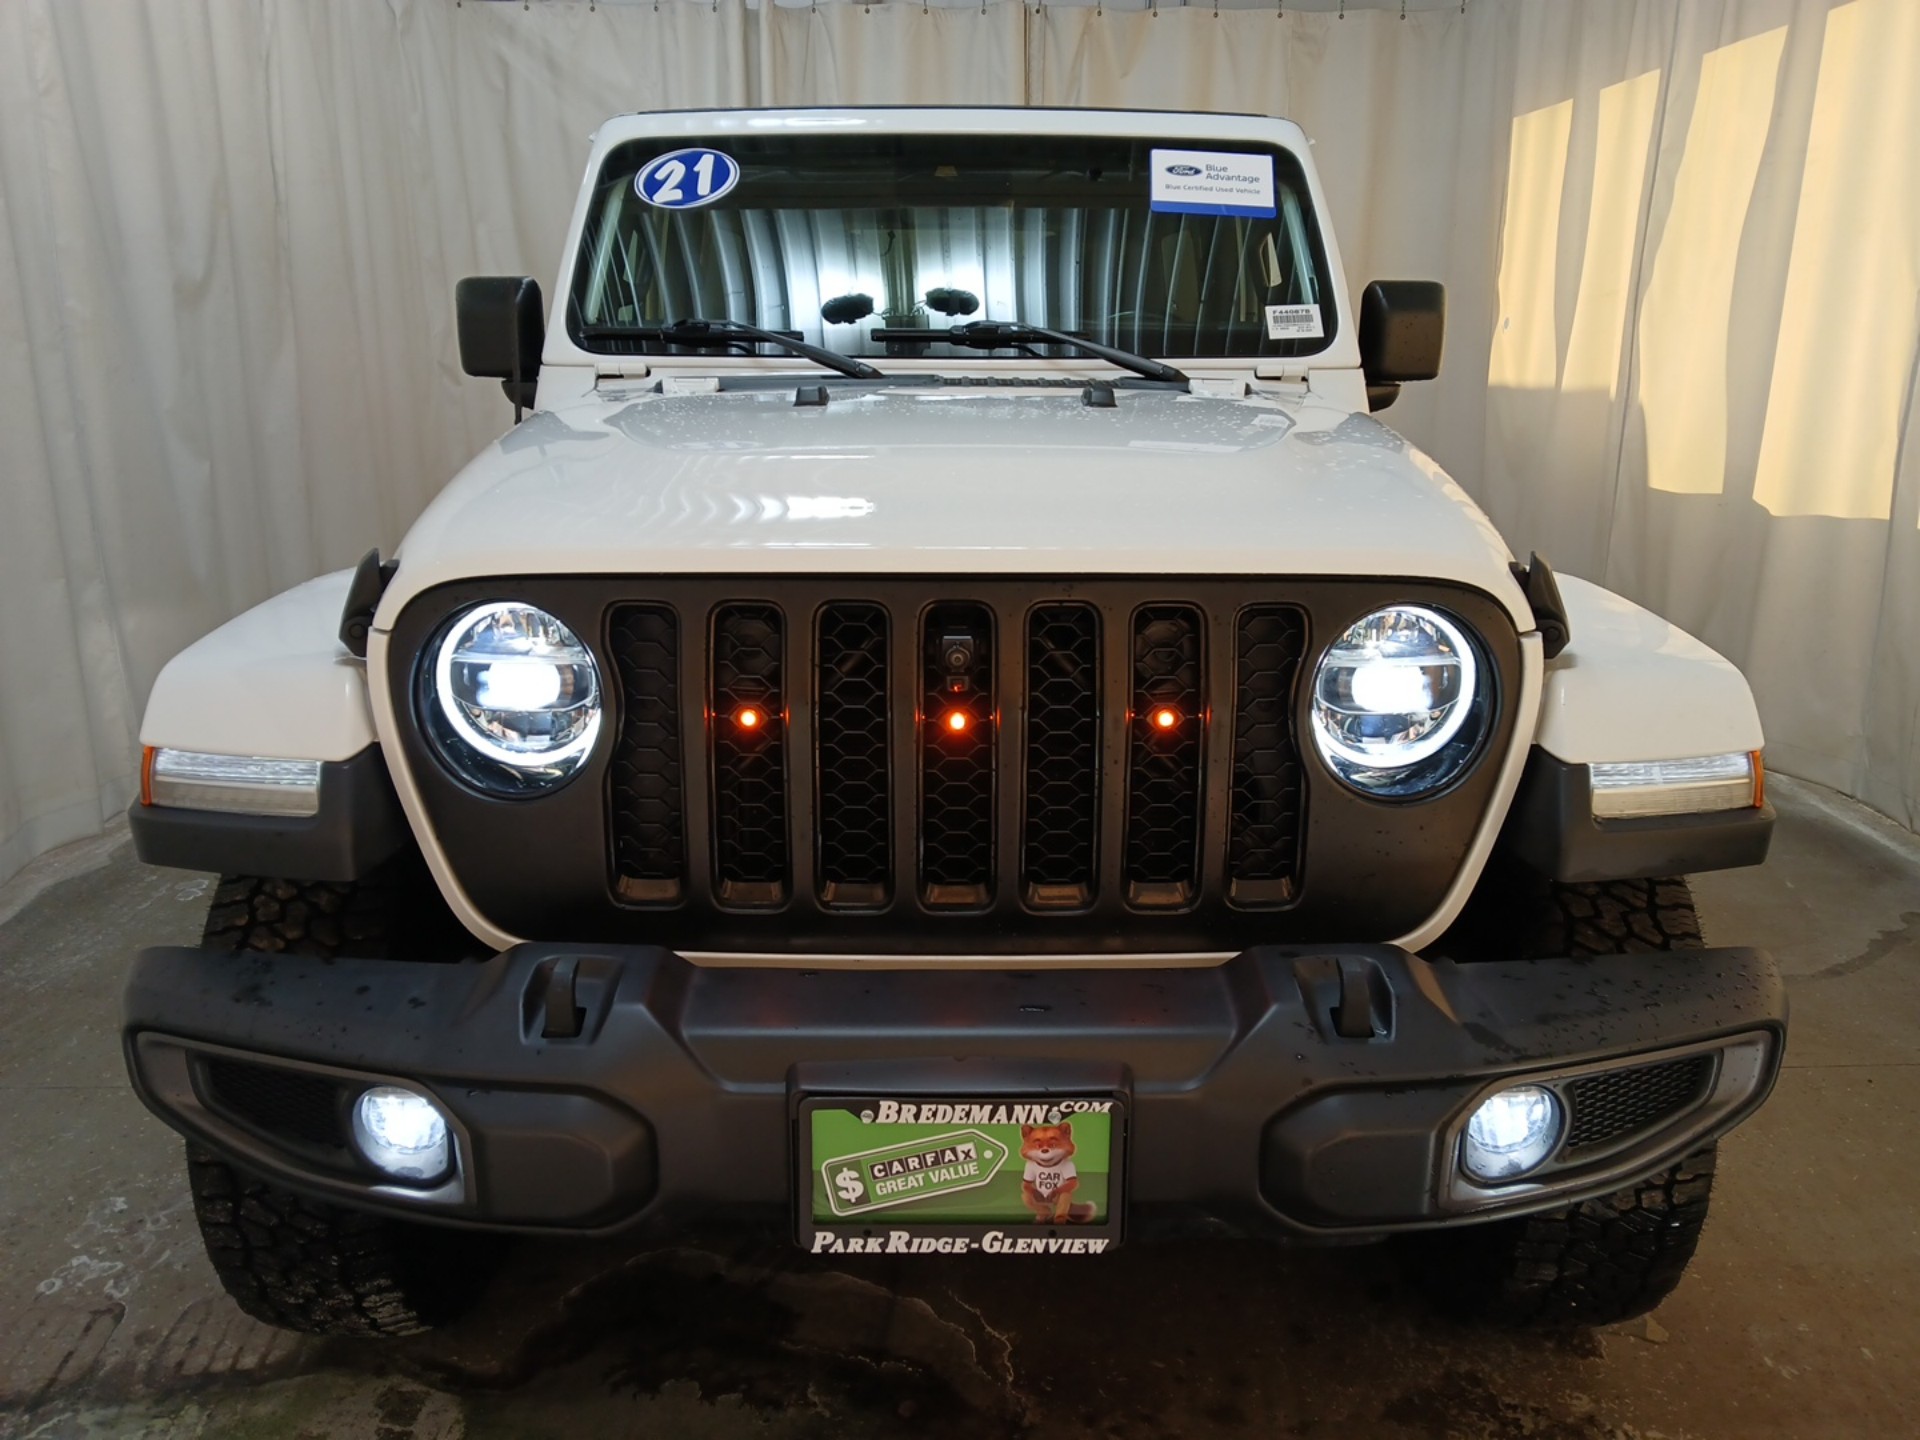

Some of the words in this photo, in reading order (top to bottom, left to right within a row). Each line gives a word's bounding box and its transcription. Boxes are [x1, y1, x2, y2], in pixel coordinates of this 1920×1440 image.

[1170, 165, 1197, 176] Ford
[1205, 164, 1228, 173] Blue
[653, 153, 714, 203] 21
[1205, 173, 1260, 184] Advantage
[872, 1147, 975, 1179] CARFAX
[876, 1174, 925, 1196] GREAT
[929, 1162, 980, 1184] VALUE
[1039, 1172, 1060, 1181] CAR
[1039, 1181, 1058, 1190] FOX
